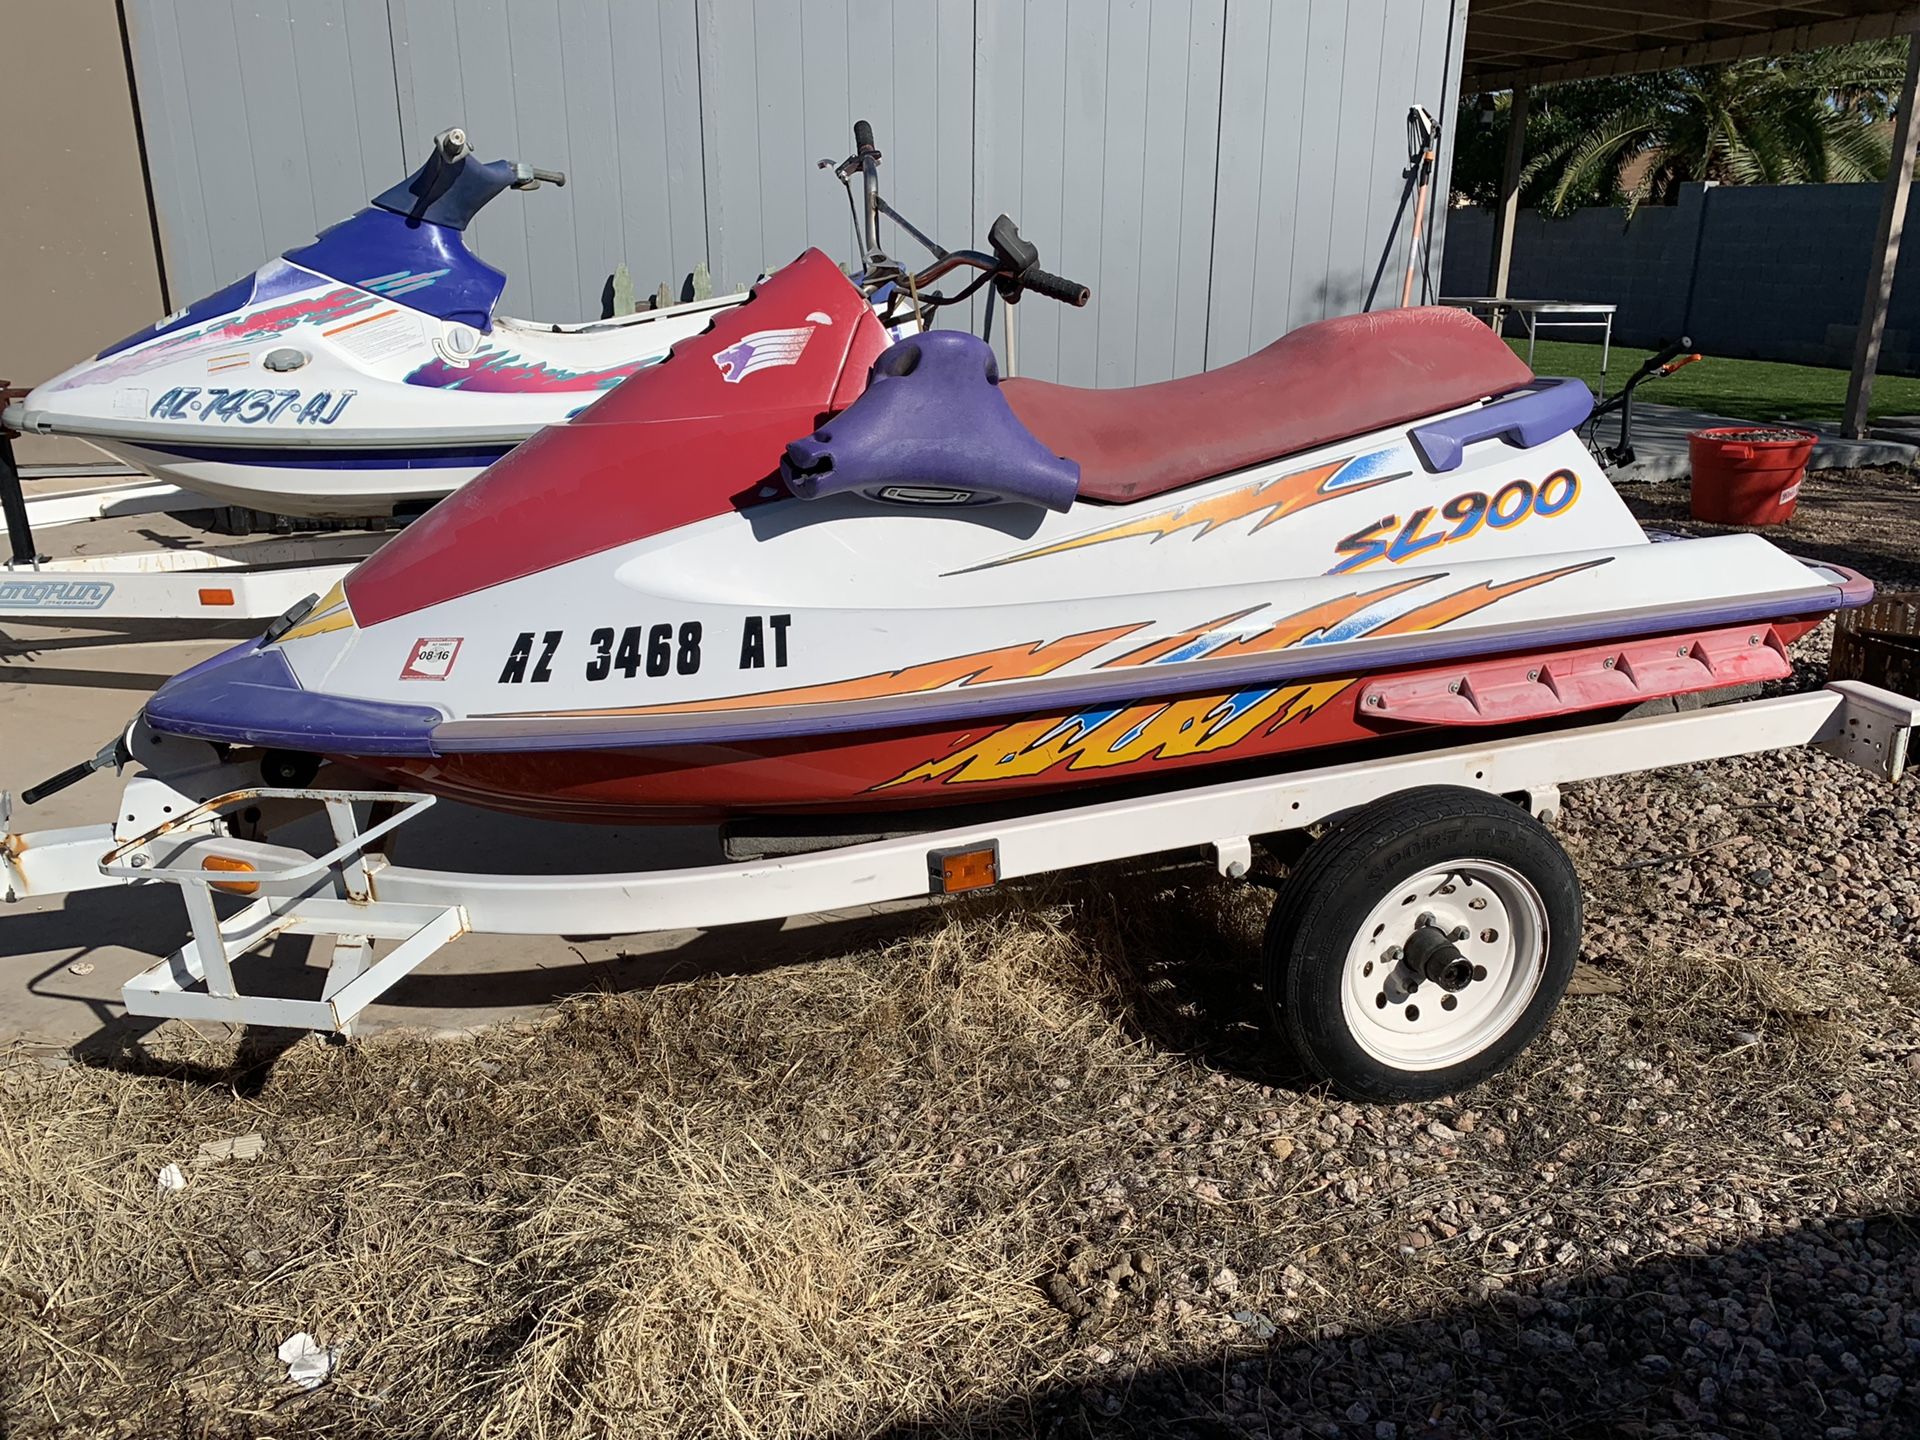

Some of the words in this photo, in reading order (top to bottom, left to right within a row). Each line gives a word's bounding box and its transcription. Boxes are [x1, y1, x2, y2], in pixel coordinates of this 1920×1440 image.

[1321, 468, 1582, 577] SL900
[0, 583, 103, 605] ongRun
[497, 630, 564, 684] AZ
[585, 620, 703, 682] 3468
[738, 613, 792, 670] AT
